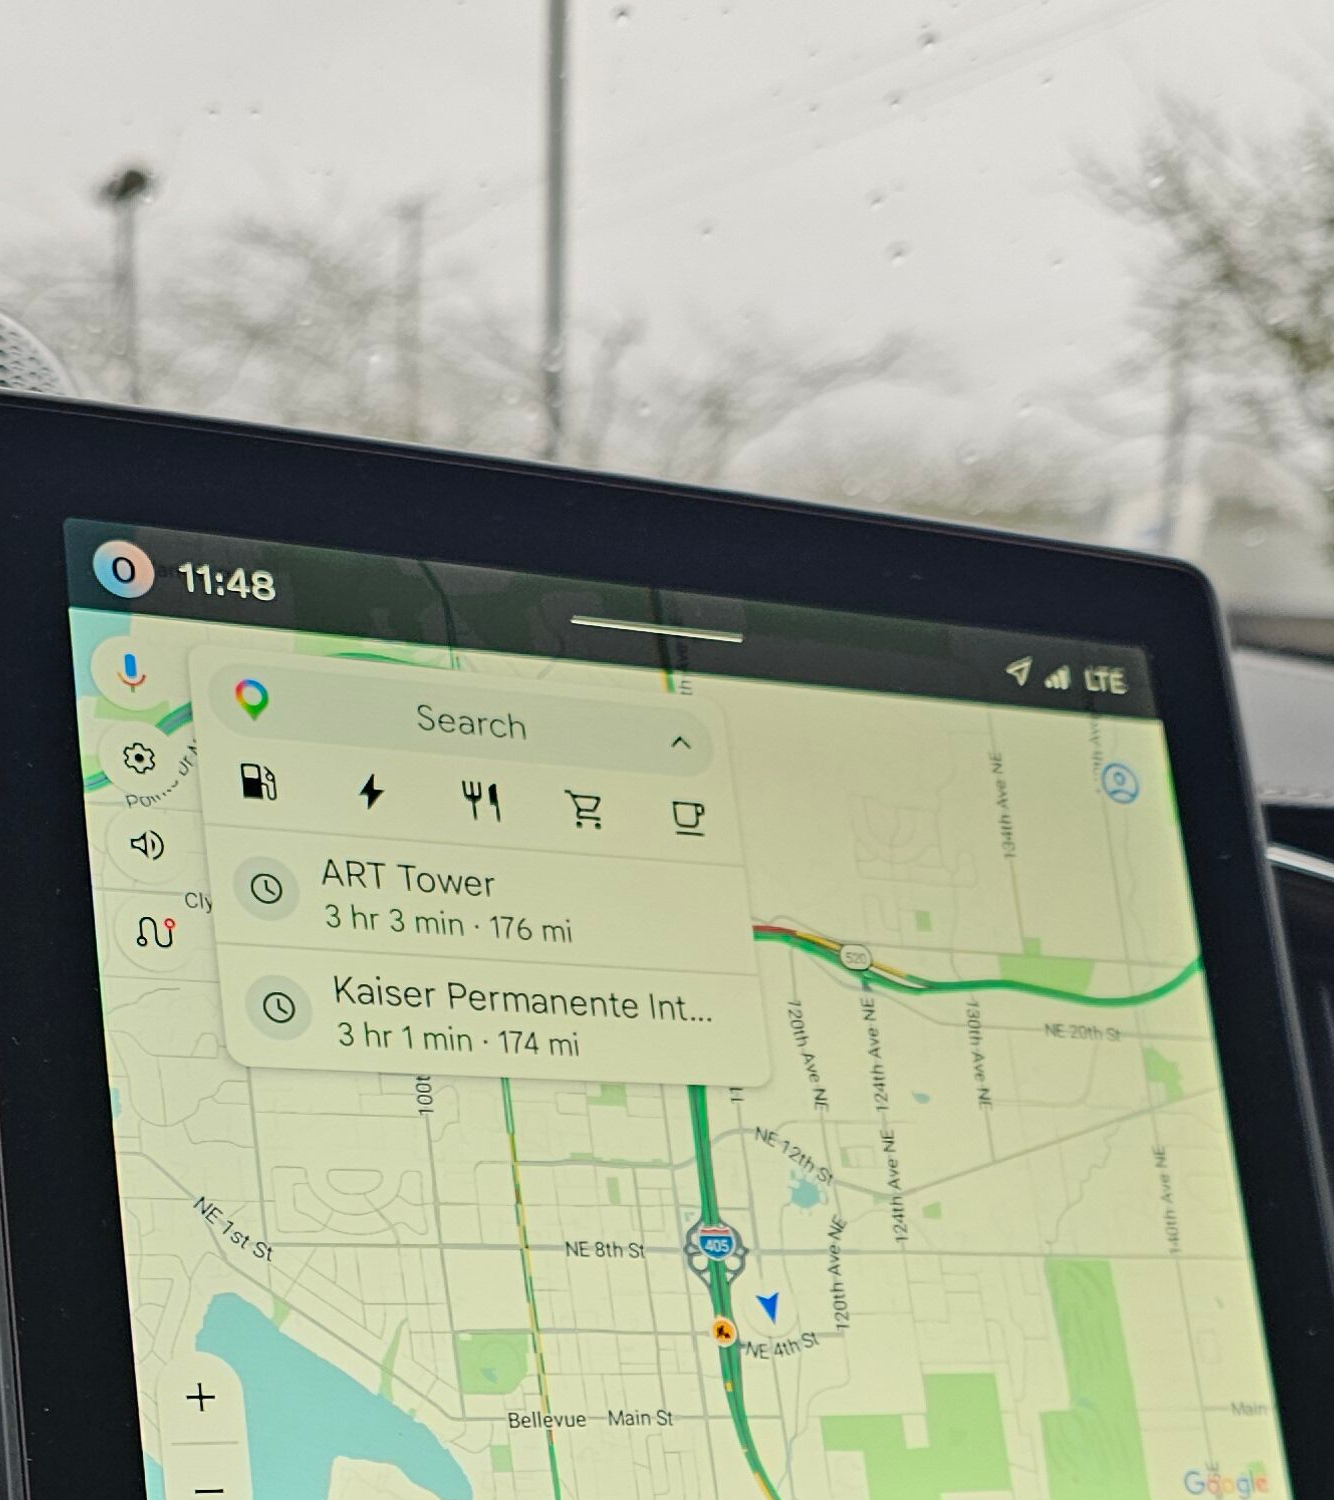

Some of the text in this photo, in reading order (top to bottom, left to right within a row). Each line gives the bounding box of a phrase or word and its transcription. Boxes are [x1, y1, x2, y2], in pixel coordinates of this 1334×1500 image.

[178, 562, 276, 601] 11:48
[1083, 666, 1129, 695] LTE
[416, 704, 527, 741] Search
[988, 752, 1016, 858] 134th Ave NE
[321, 858, 495, 897] ART Tower
[325, 905, 573, 943] 3 hr 3 min 176 mi
[846, 952, 867, 965] 520
[333, 975, 713, 1023] Kaiser Permanente Int...
[338, 1022, 580, 1057] 3 hr 1 min 174 mi
[1044, 1023, 1121, 1042] NE 20th St
[787, 1000, 830, 1112] 120th Ave NE
[860, 997, 889, 1112] 124th Ave NE
[966, 1001, 993, 1111] 130th Ave NE
[754, 1127, 835, 1187] NE 12th St
[1152, 1145, 1168, 1169] NE
[880, 1129, 910, 1244] 124th Ave NE
[1160, 1174, 1173, 1204] Ave
[192, 1196, 274, 1263] NE 1st St
[704, 1238, 729, 1253] 405
[565, 1241, 646, 1259] NE 8th St
[827, 1214, 851, 1332] 120th Ave NE
[745, 1332, 820, 1361] NE 4th St
[508, 1411, 587, 1429] Bellevue
[608, 1410, 674, 1427] Main St
[1184, 1469, 1269, 1500] Google
